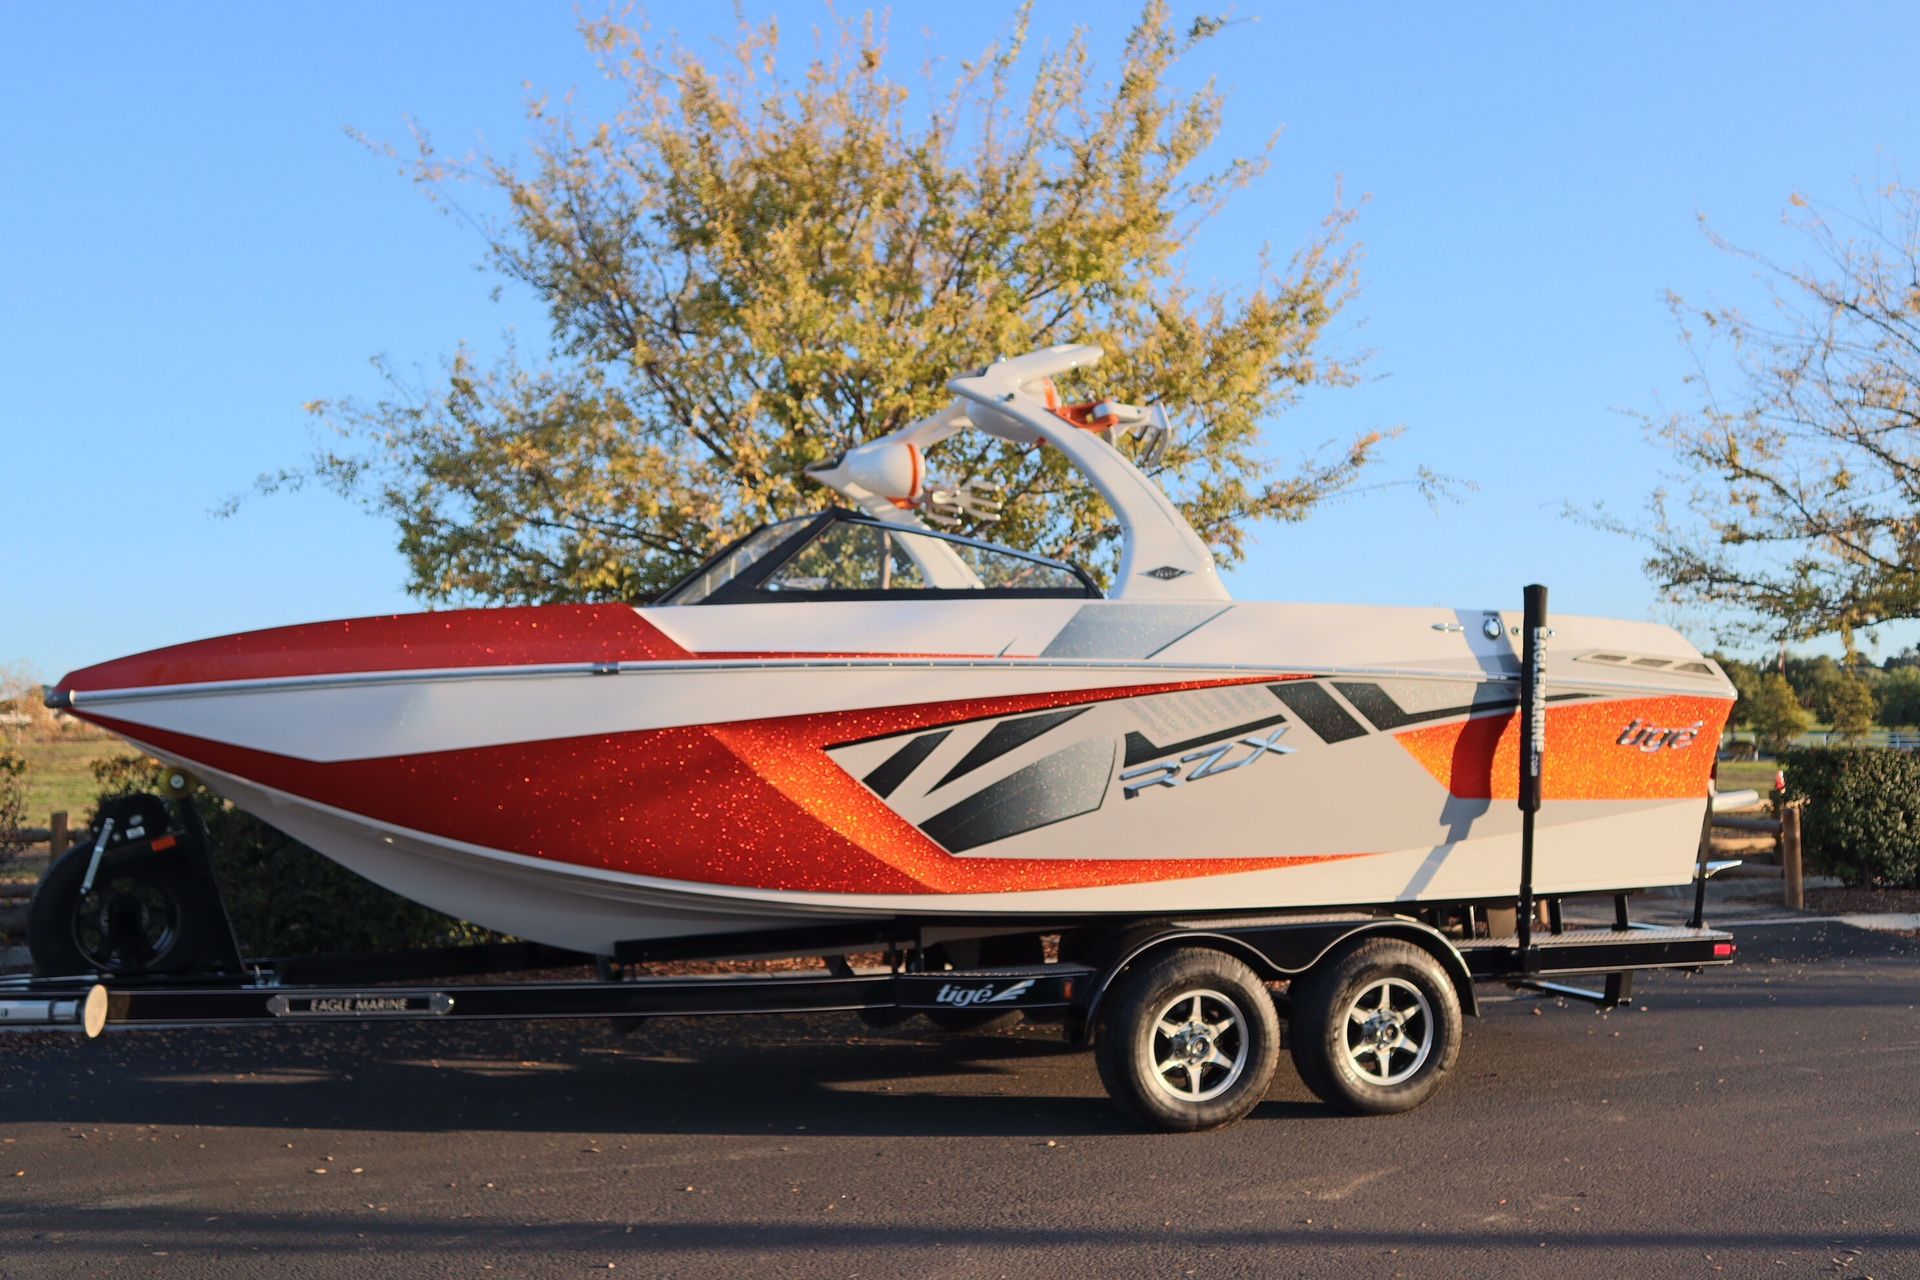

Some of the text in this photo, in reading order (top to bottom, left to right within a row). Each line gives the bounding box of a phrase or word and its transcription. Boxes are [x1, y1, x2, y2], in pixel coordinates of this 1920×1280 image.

[1119, 727, 1298, 800] RZX
[310, 997, 408, 1012] EAGLE MARINE
[936, 984, 994, 1007] tigé
